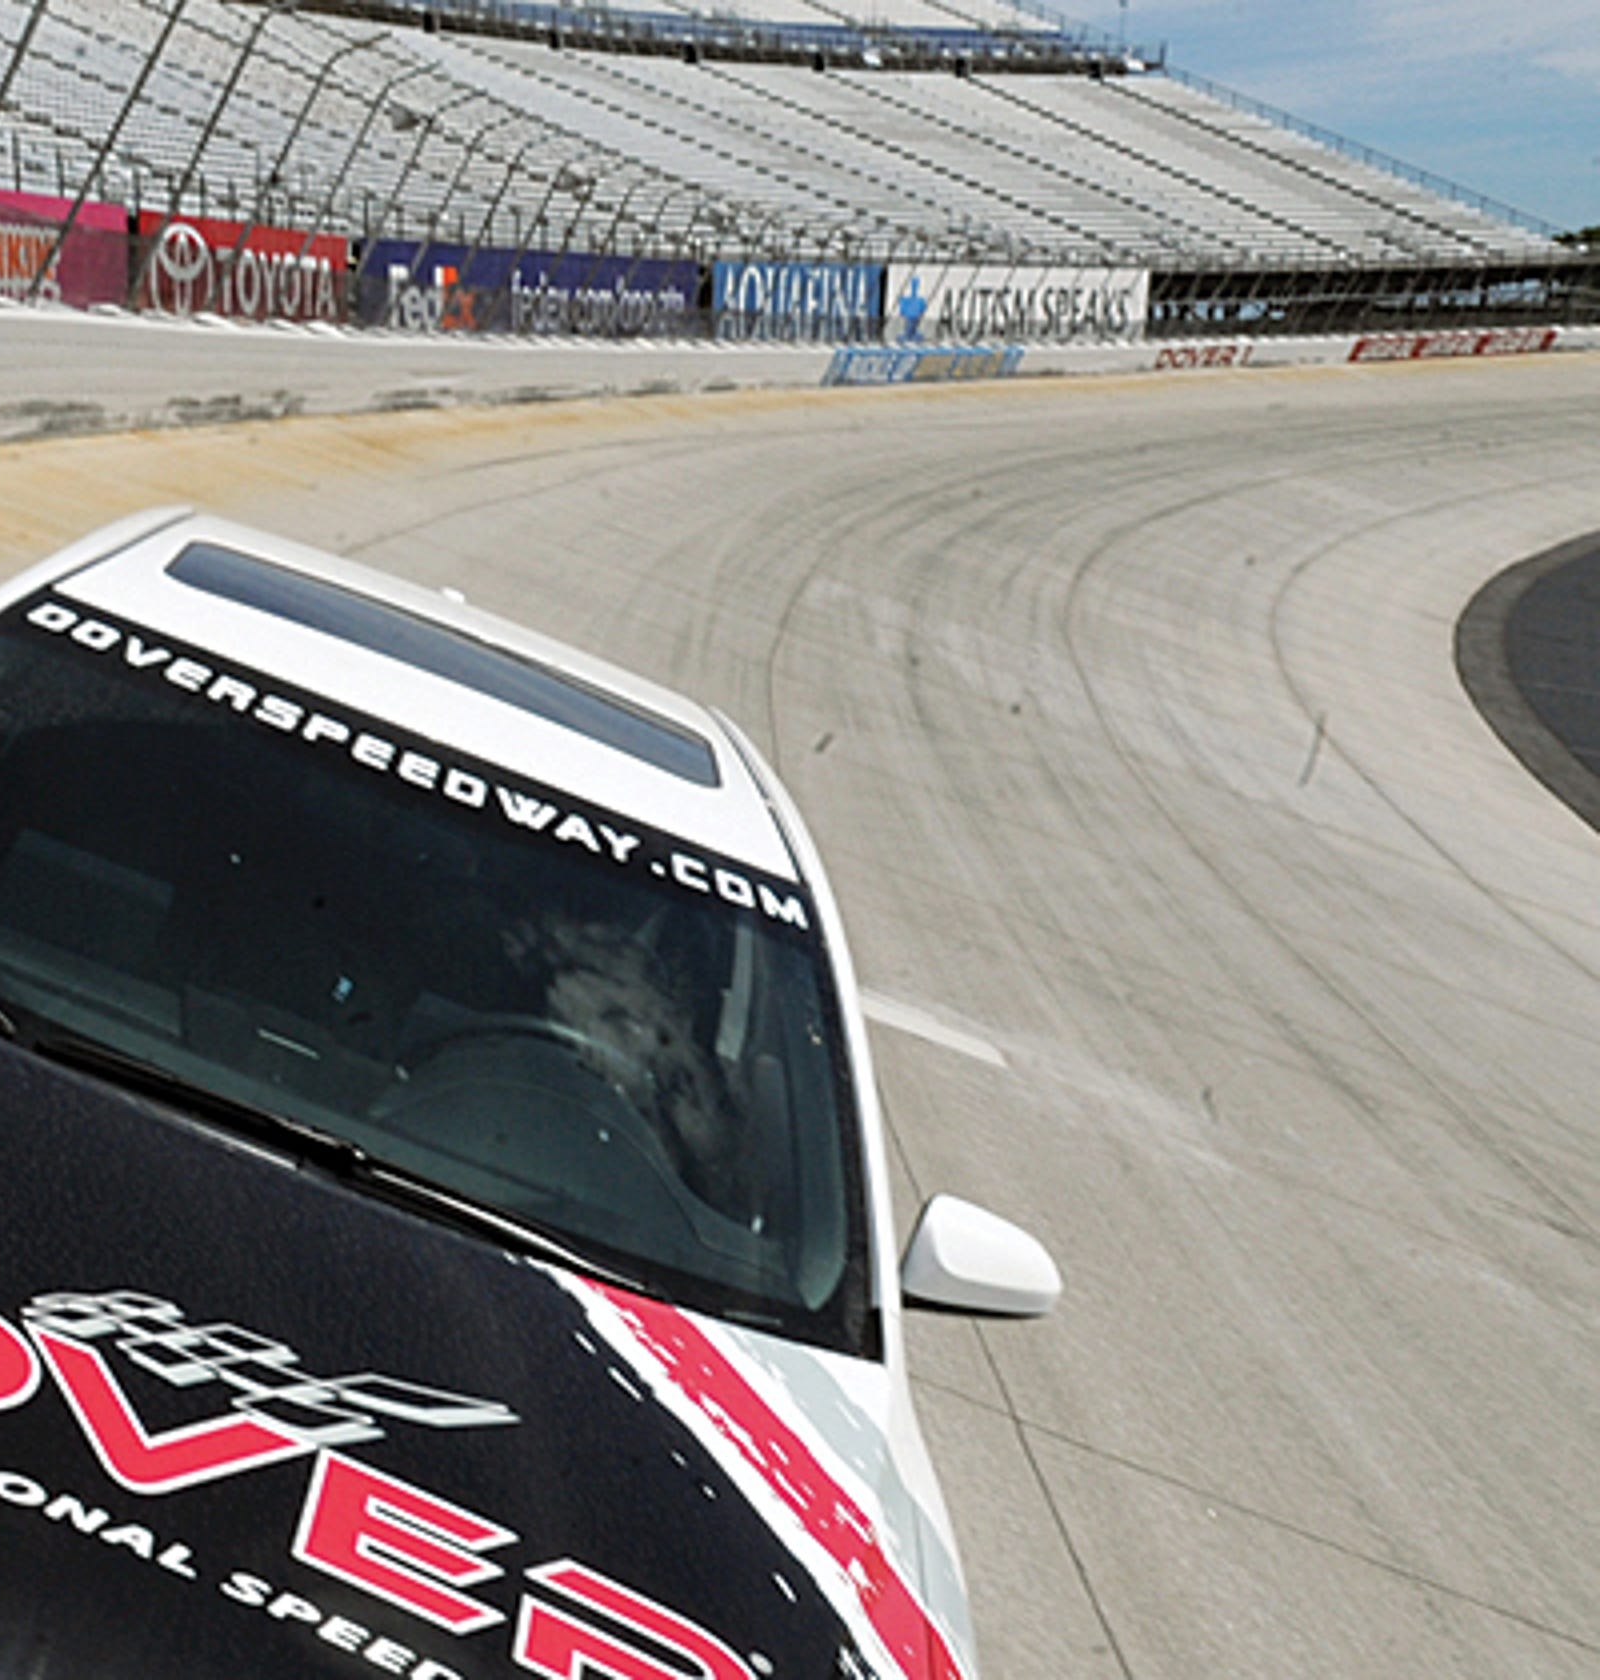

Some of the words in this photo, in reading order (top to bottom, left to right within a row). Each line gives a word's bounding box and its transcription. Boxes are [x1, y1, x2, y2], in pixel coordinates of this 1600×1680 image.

[215, 246, 338, 318] TOYOTA
[388, 263, 476, 333] FedEx
[718, 264, 876, 342] AQUAFINA
[936, 287, 1036, 341] AUTISM
[1043, 287, 1131, 341] SPEAKS
